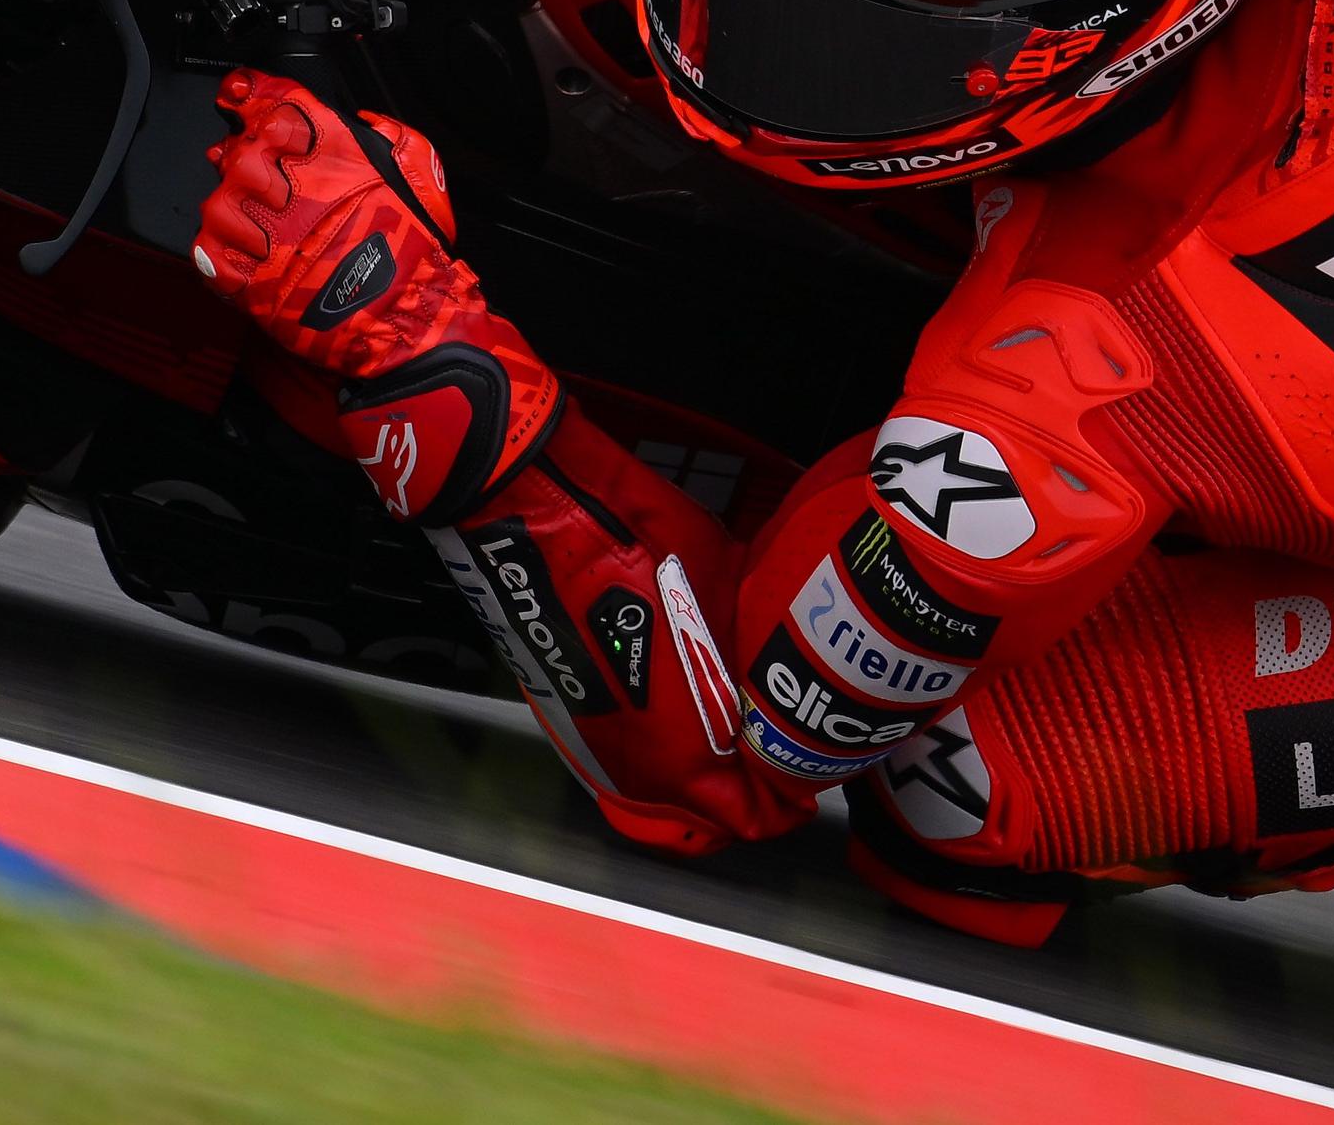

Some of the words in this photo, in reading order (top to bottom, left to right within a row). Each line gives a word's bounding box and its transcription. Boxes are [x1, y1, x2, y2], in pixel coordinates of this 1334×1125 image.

[1067, 4, 1129, 31] TICAL
[819, 141, 998, 173] Lenovo
[479, 537, 586, 700] Lenovo
[880, 554, 977, 637] MONSTER
[882, 585, 955, 639] ENERGY
[828, 620, 953, 693] riello
[767, 661, 916, 744] elica
